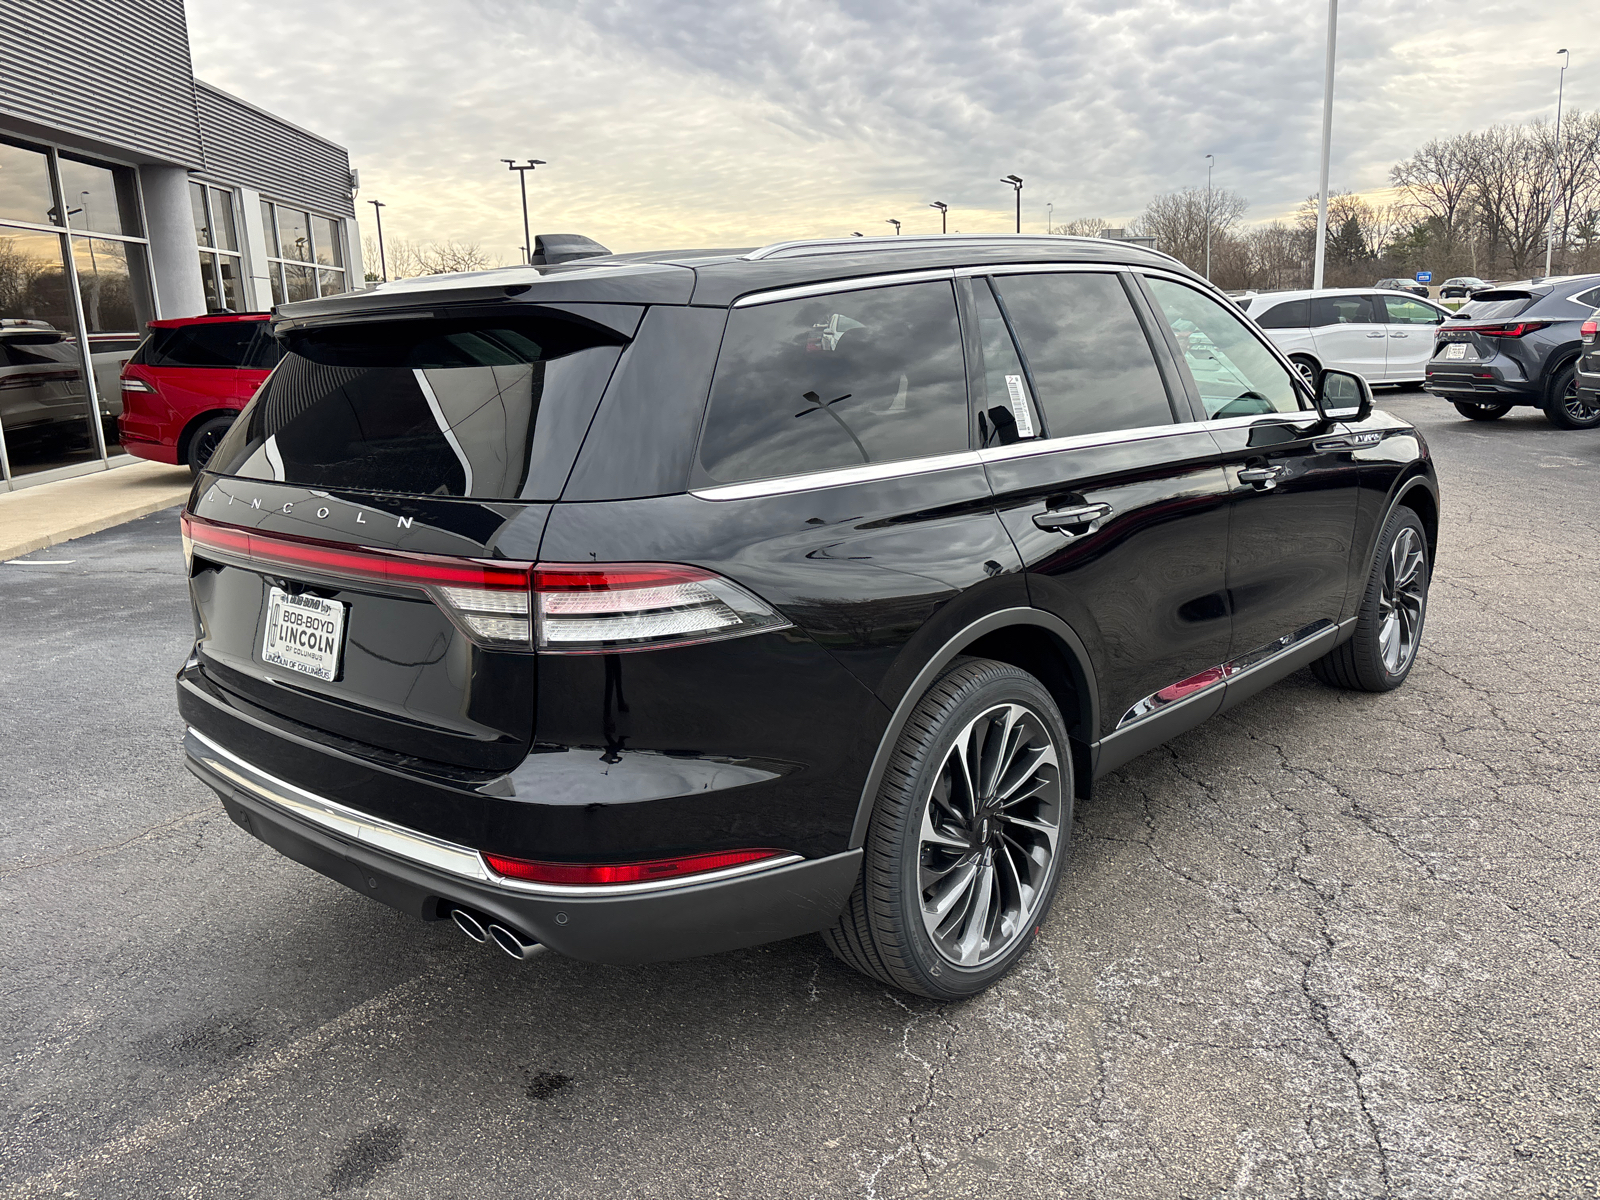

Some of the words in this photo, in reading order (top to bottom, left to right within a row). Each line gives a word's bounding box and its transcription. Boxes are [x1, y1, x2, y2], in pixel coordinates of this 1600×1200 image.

[208, 491, 413, 529] LINCOLN
[283, 610, 335, 634] BOB-BOYD
[279, 624, 335, 655] LINCOLN
[265, 653, 288, 667] LINCOLN
[288, 661, 297, 669] OF
[297, 663, 330, 680] COLUMBUS
[293, 648, 323, 661] COLUMBUS
